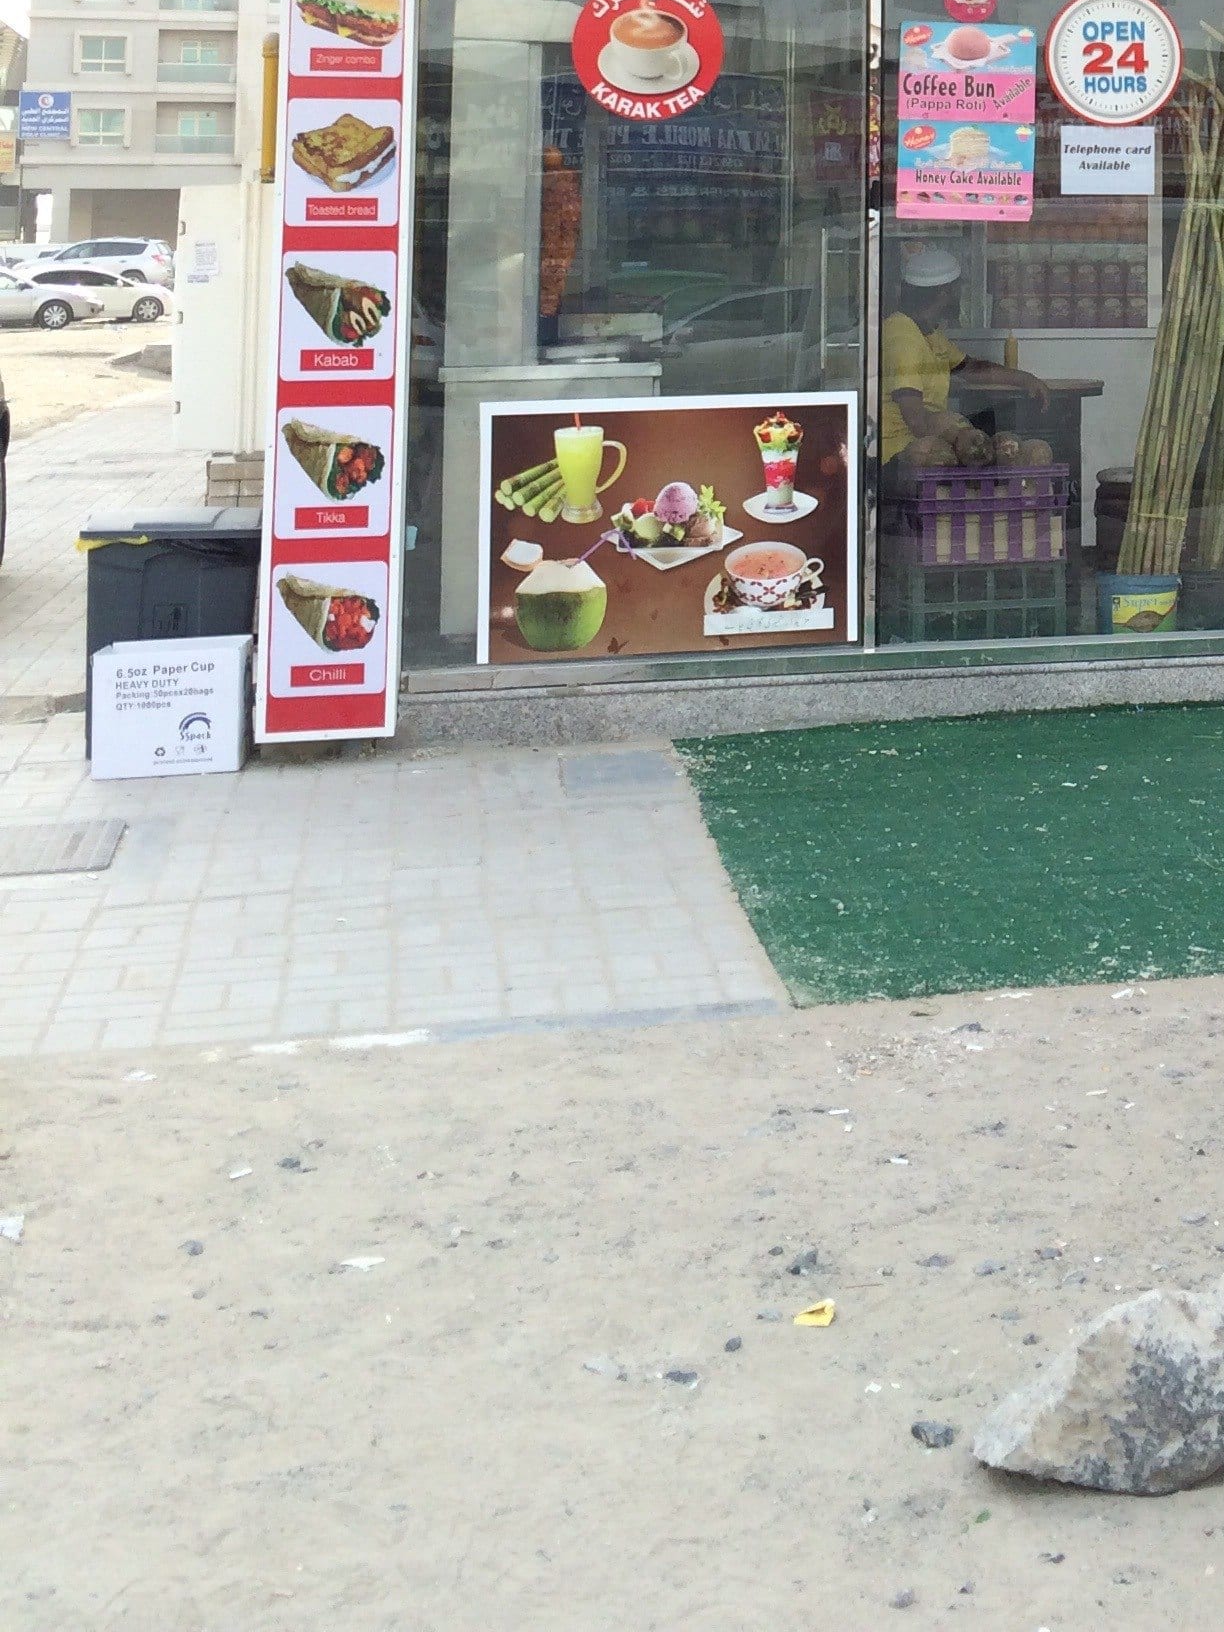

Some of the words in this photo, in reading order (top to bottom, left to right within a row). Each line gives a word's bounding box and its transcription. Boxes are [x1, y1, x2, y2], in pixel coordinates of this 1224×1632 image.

[1082, 21, 1146, 42] OPEN
[1082, 41, 1150, 76] 24
[902, 73, 958, 97] Coffee
[964, 74, 995, 98] Bun
[992, 77, 1032, 111] Available
[1084, 76, 1148, 94] HOURS
[590, 81, 662, 119] KARAK
[662, 85, 706, 114] TEA
[906, 97, 952, 111] (Pappa
[956, 99, 987, 112] Roti)
[1063, 144, 1121, 156] Telephone
[1125, 144, 1152, 155] card
[1078, 160, 1131, 171] Available
[915, 169, 946, 185] Honey
[949, 170, 974, 185] Cake
[976, 170, 1022, 186] Available
[308, 204, 346, 216] Toasted
[347, 204, 376, 216] bread
[314, 353, 359, 368] Kabab
[316, 511, 346, 524] Tikka
[116, 668, 148, 679] 6.5oz
[153, 664, 188, 676] Paper
[190, 661, 216, 673] Cup
[308, 669, 347, 682] Chilli
[115, 680, 149, 690] HEAVY
[151, 678, 179, 689] DUTY
